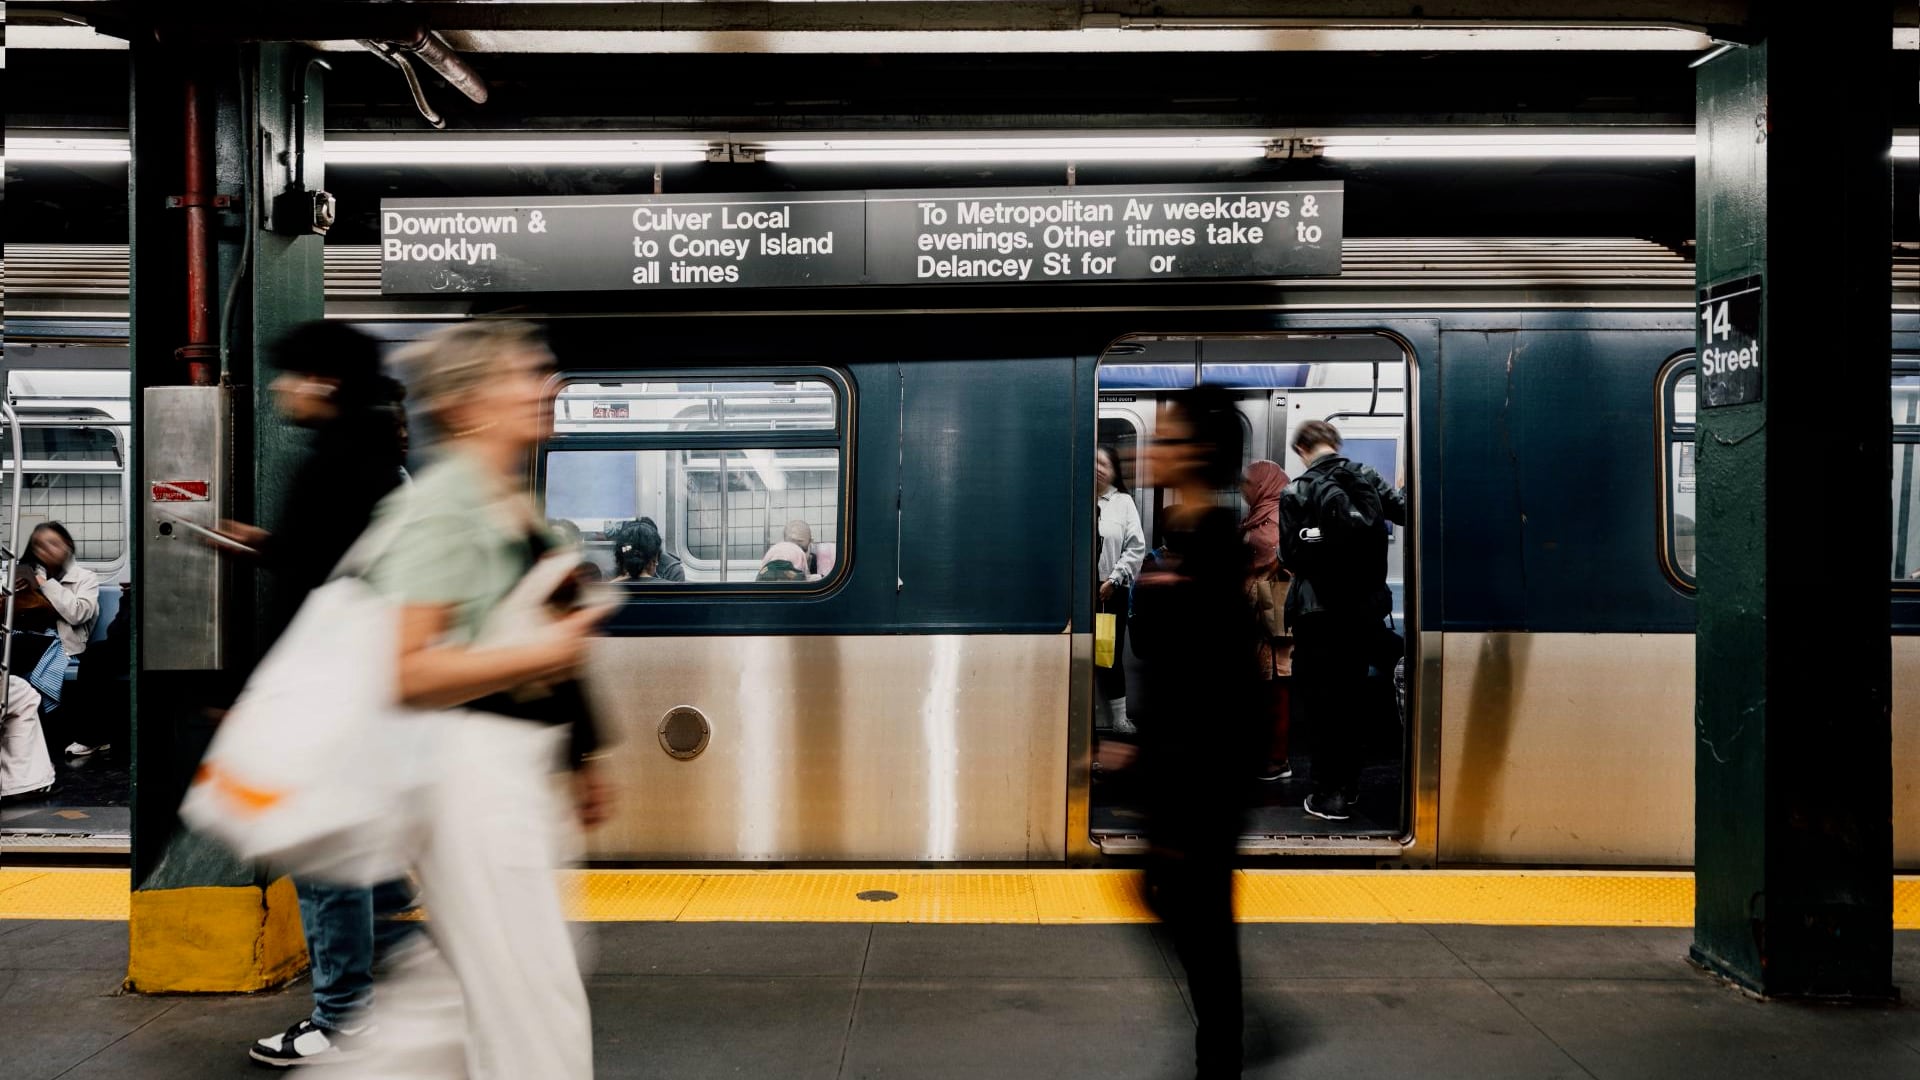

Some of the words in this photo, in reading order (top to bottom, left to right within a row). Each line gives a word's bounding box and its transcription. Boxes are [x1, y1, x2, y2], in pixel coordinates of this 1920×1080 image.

[383, 211, 517, 234] Downtown
[527, 209, 547, 234] &
[632, 208, 712, 231] Culver
[721, 206, 790, 230] Local
[918, 202, 948, 226] To
[957, 199, 1113, 229] Metropolitan
[1122, 198, 1154, 222] Av
[1162, 196, 1290, 223] weekdays
[1299, 194, 1319, 217] &
[383, 238, 497, 265] Brooklyn
[632, 235, 659, 258] to
[668, 233, 751, 261] Coney
[760, 231, 833, 256] Island
[917, 227, 1034, 255] evenings.
[1043, 224, 1116, 249] Other
[1125, 223, 1196, 246] times
[1206, 221, 1264, 245] take
[1296, 221, 1322, 243] to
[632, 260, 660, 284] all
[669, 260, 739, 284] times
[917, 251, 1033, 281] Delancey
[1042, 251, 1071, 276] St
[1080, 251, 1117, 275] for
[1149, 255, 1176, 273] or
[1701, 300, 1732, 345] 14
[1702, 339, 1759, 377] Street
